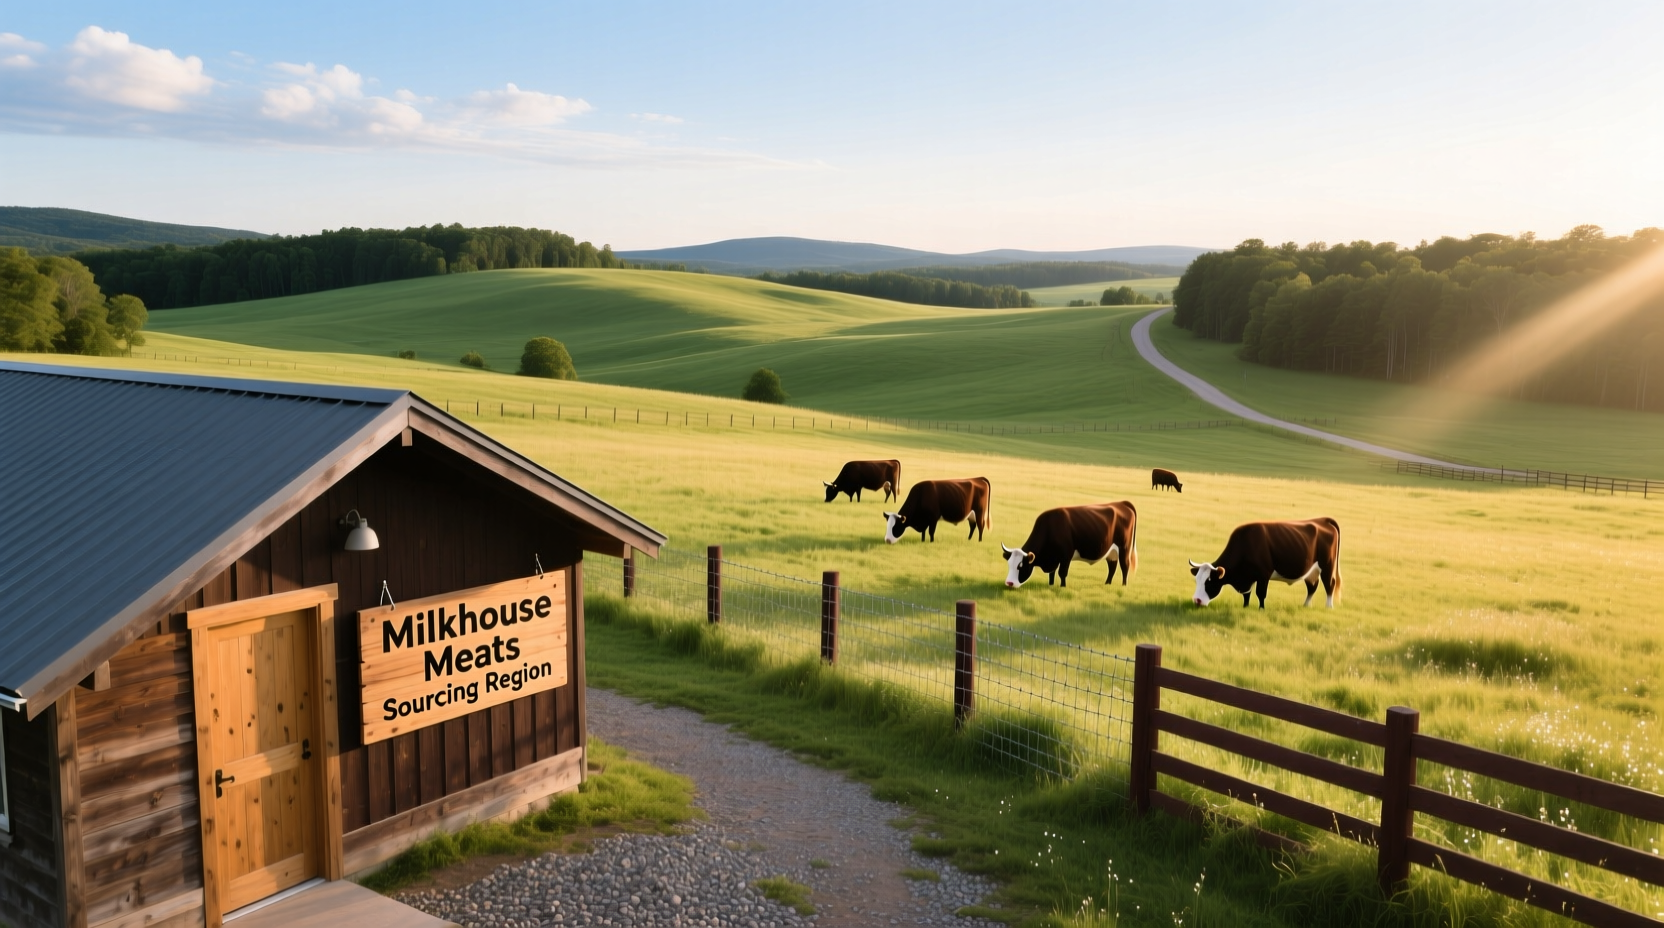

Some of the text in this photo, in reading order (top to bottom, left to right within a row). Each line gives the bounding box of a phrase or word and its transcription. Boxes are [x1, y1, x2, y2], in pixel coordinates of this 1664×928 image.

[382, 595, 552, 654] Milkhouse
[424, 635, 521, 682] Meats
[383, 661, 552, 721] Sourcing Region
